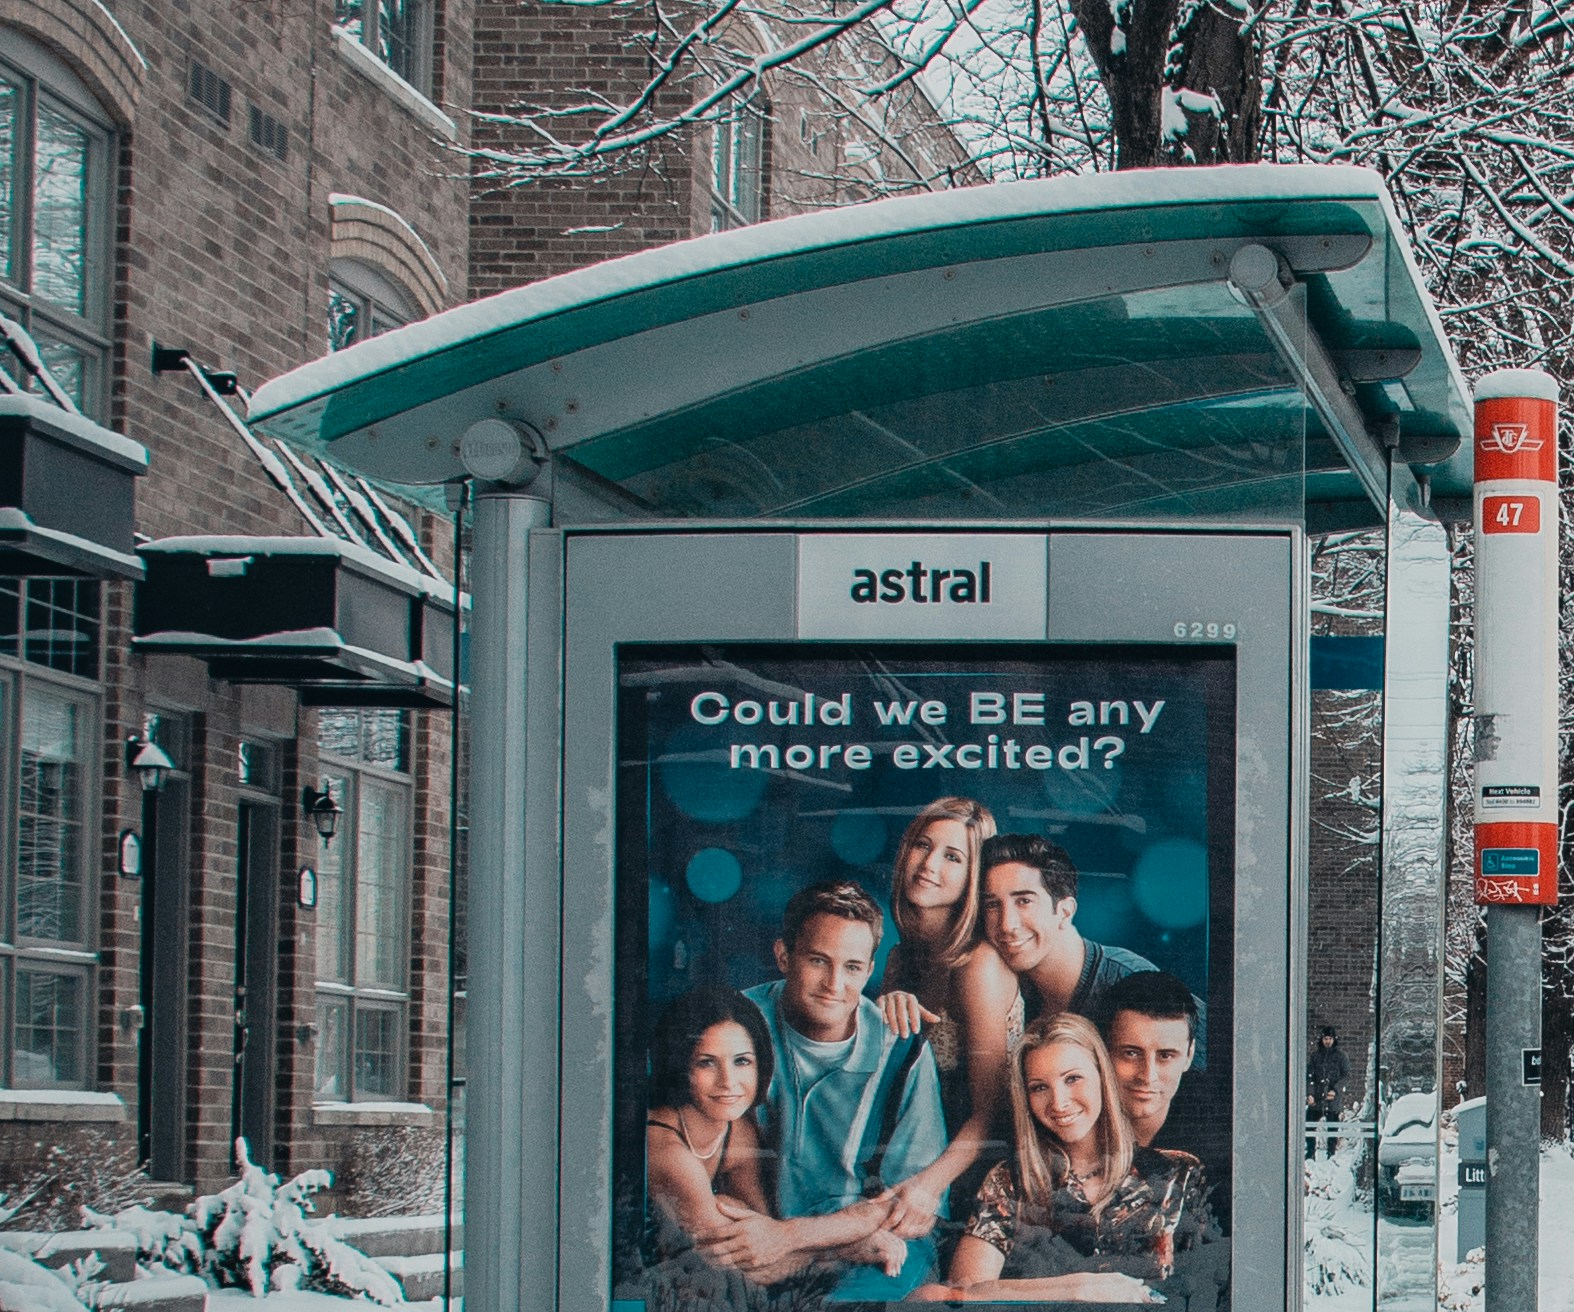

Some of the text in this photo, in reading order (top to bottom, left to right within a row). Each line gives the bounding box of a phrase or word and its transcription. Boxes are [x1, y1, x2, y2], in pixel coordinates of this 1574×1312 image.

[1496, 503, 1524, 527] 47
[850, 560, 991, 604] astral
[1173, 621, 1237, 640] 6299
[690, 691, 1166, 734] Could we BE any
[729, 734, 1126, 771] more excited?
